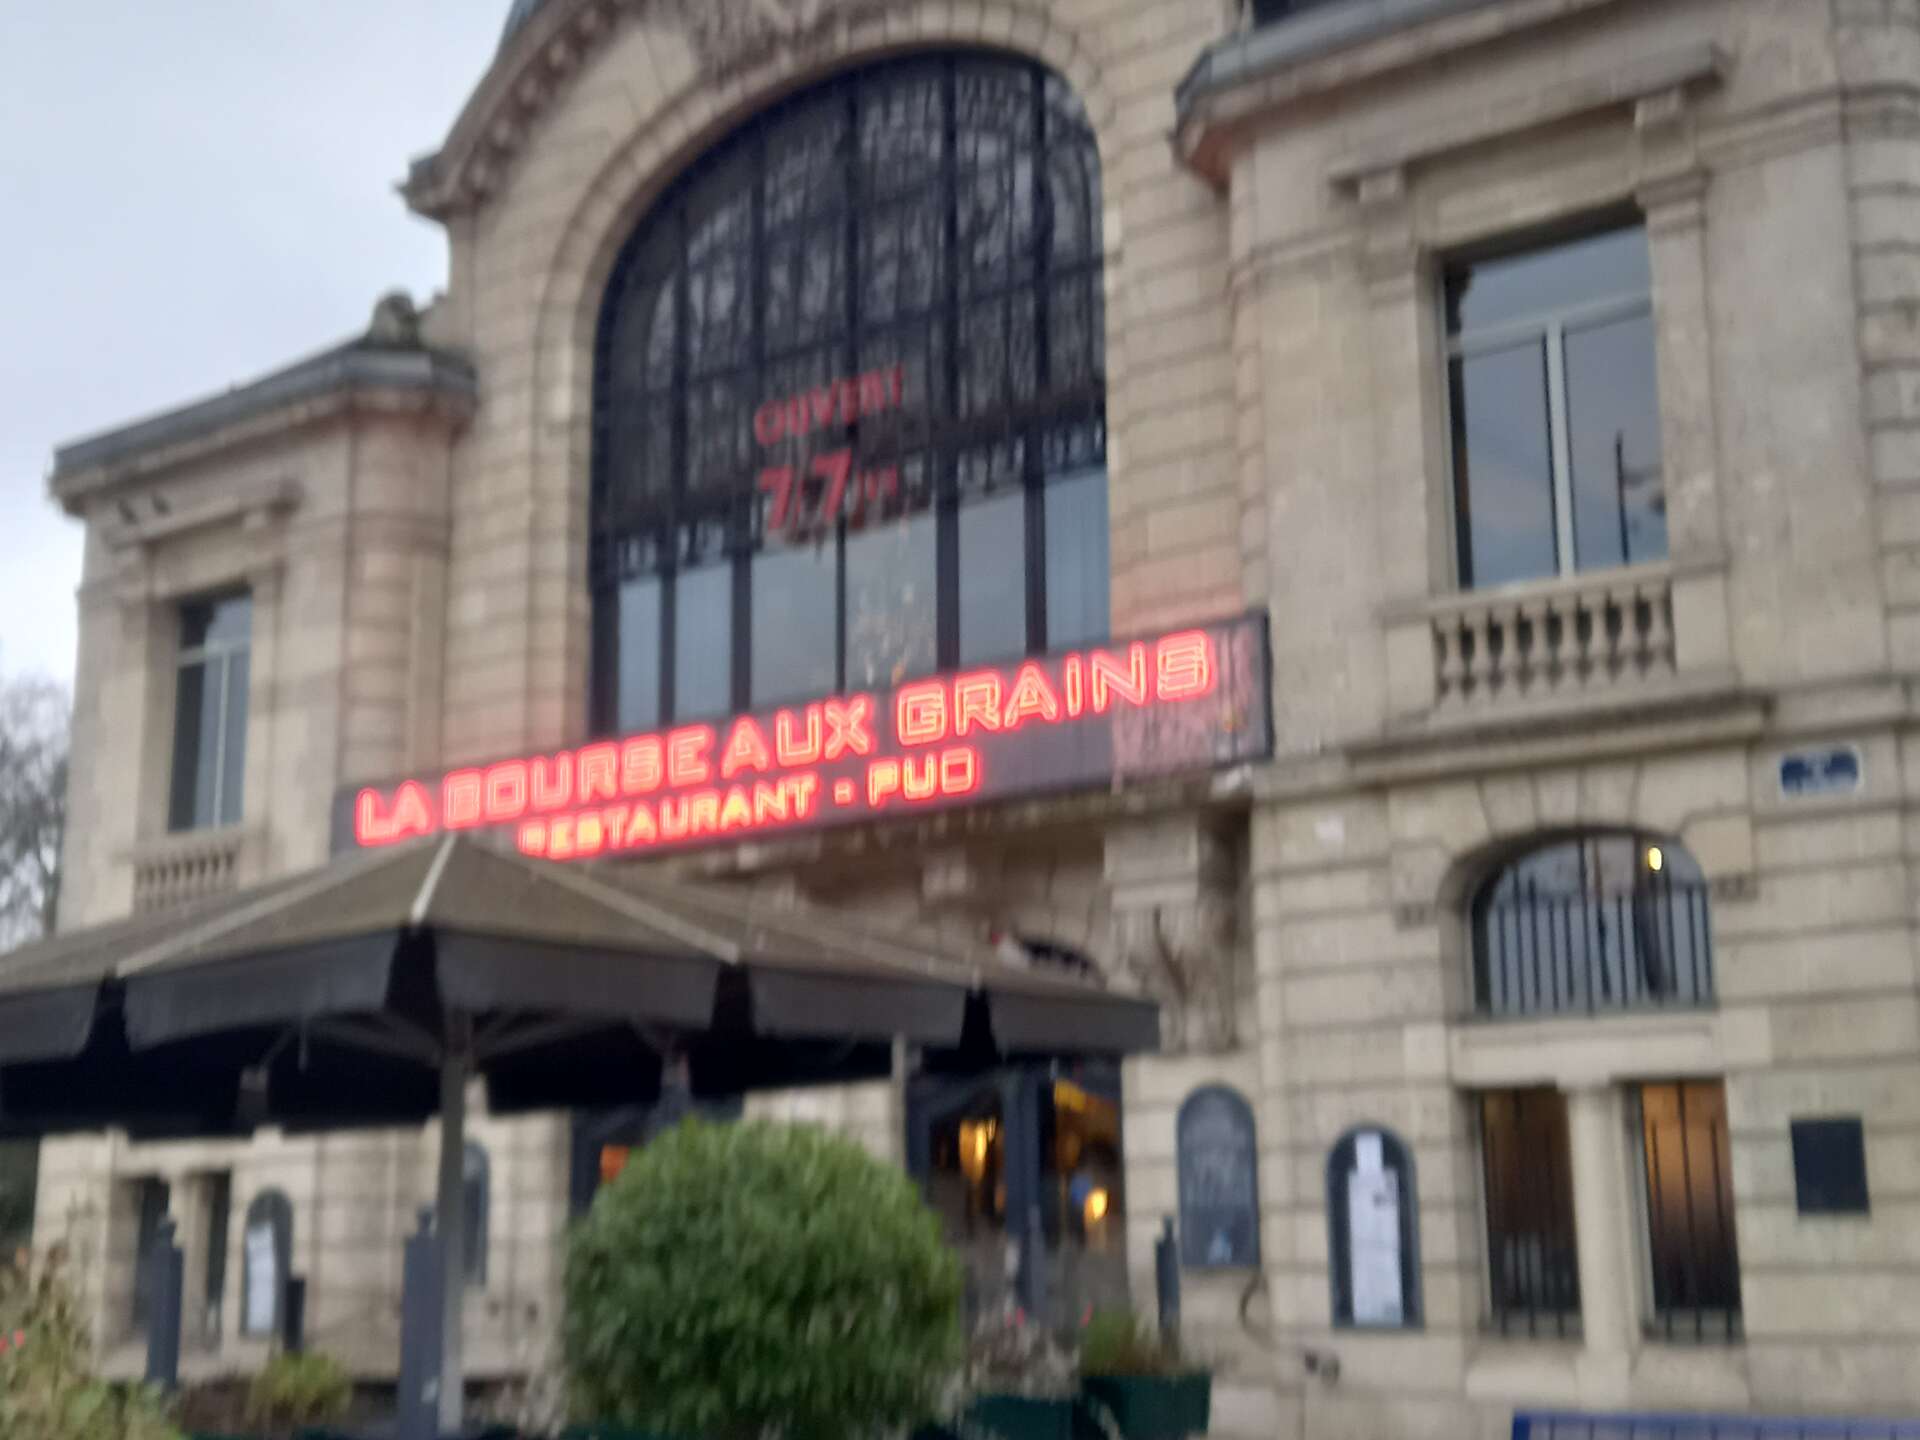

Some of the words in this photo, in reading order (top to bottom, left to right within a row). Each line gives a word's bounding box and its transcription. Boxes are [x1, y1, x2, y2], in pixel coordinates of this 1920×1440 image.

[356, 781, 431, 846] LA
[443, 725, 711, 829] BOURSE
[721, 695, 870, 779] AUX
[897, 630, 1212, 746] GRAINS
[519, 772, 817, 860] RESTAURANT
